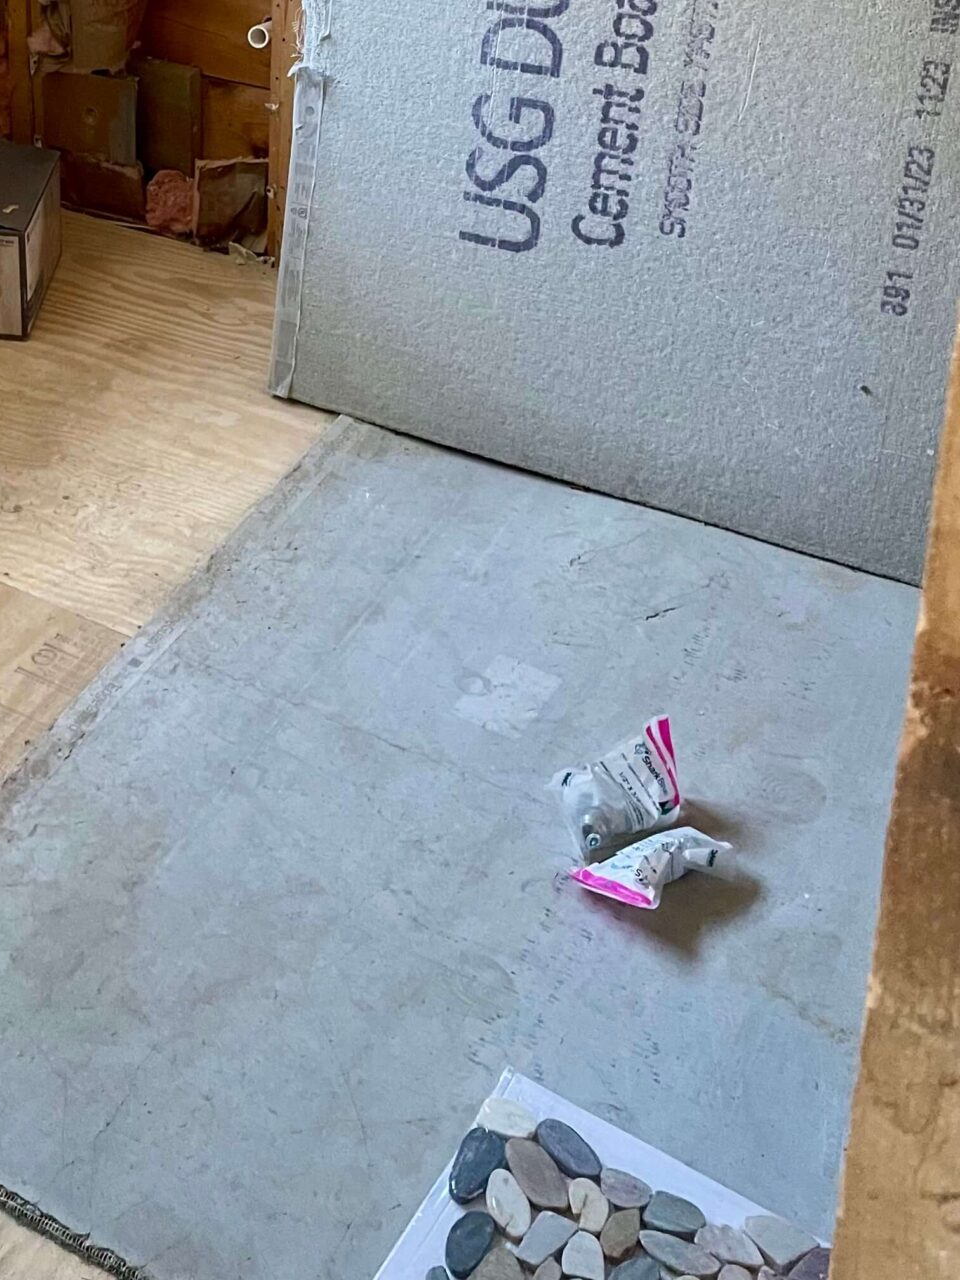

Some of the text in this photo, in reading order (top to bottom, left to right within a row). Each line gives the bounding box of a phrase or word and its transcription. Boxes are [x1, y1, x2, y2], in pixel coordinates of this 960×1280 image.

[458, 92, 555, 254] USG
[570, 83, 646, 249] Cement
[892, 144, 937, 251] 01/31/23
